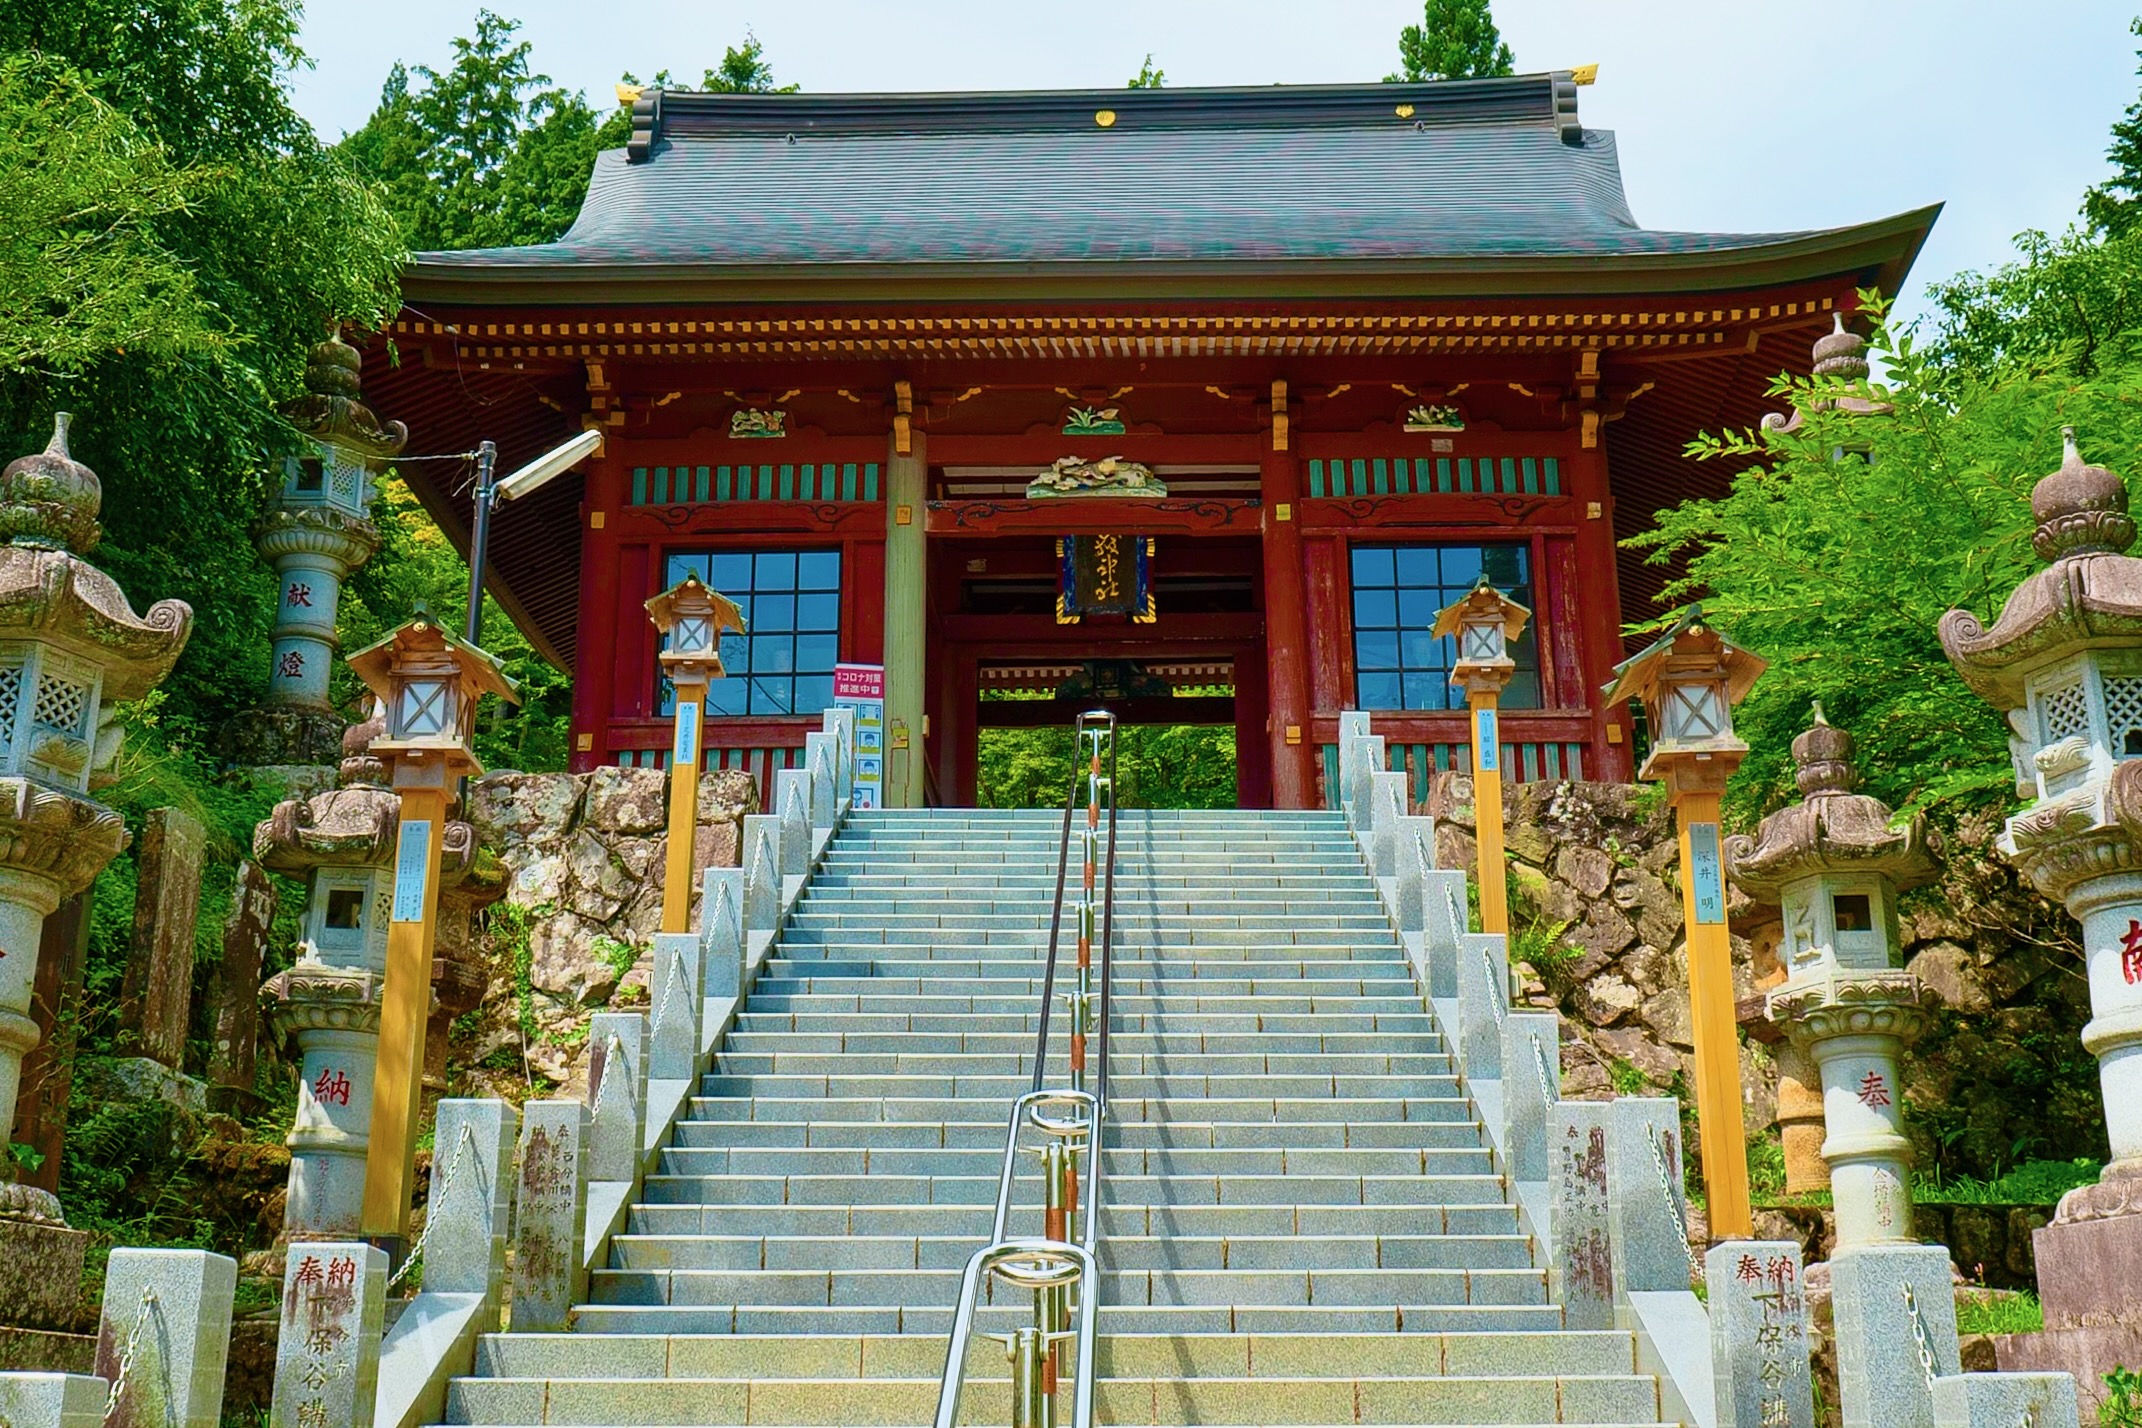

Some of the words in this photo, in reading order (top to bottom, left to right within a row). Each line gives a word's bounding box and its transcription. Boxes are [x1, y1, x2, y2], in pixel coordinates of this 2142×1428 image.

[314, 1069, 351, 1106] 納
[1857, 1071, 1891, 1114] 奉
[296, 1255, 356, 1284] 奉納
[1736, 1254, 1796, 1284] 奉納
